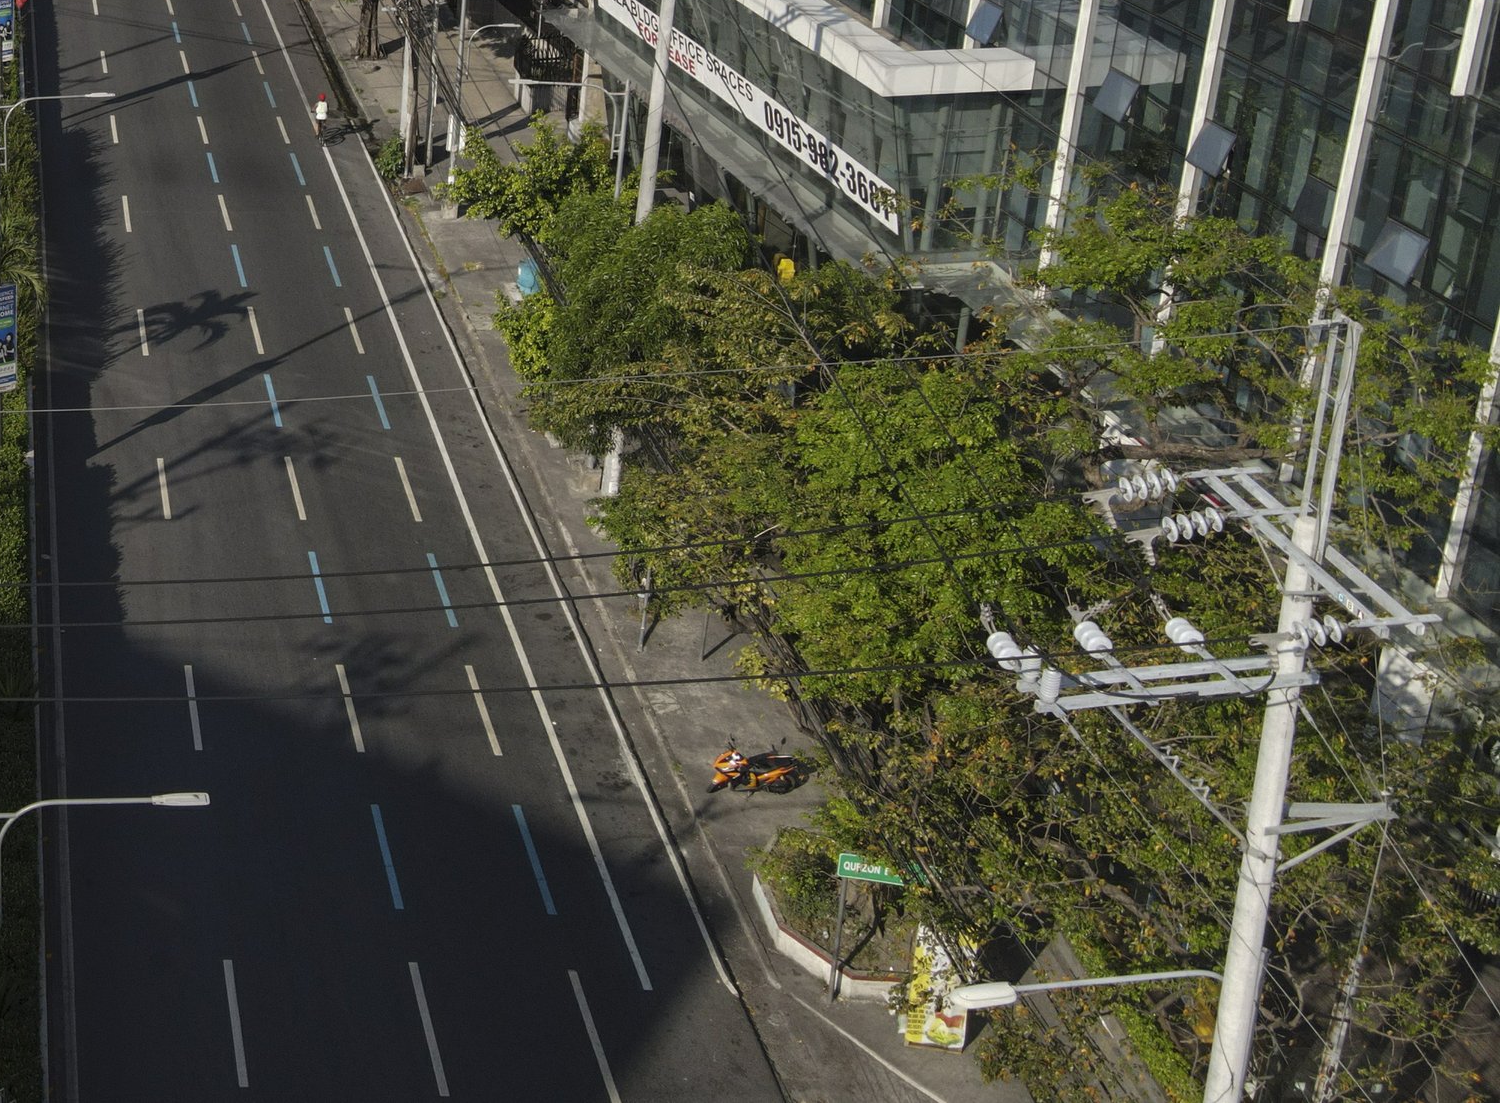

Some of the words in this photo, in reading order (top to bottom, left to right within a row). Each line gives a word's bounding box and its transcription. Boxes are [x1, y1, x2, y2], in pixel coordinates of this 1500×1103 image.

[638, 22, 658, 46] FOR
[669, 46, 696, 76] EASE
[670, 30, 703, 65] FFICE
[705, 53, 754, 102] SPACES
